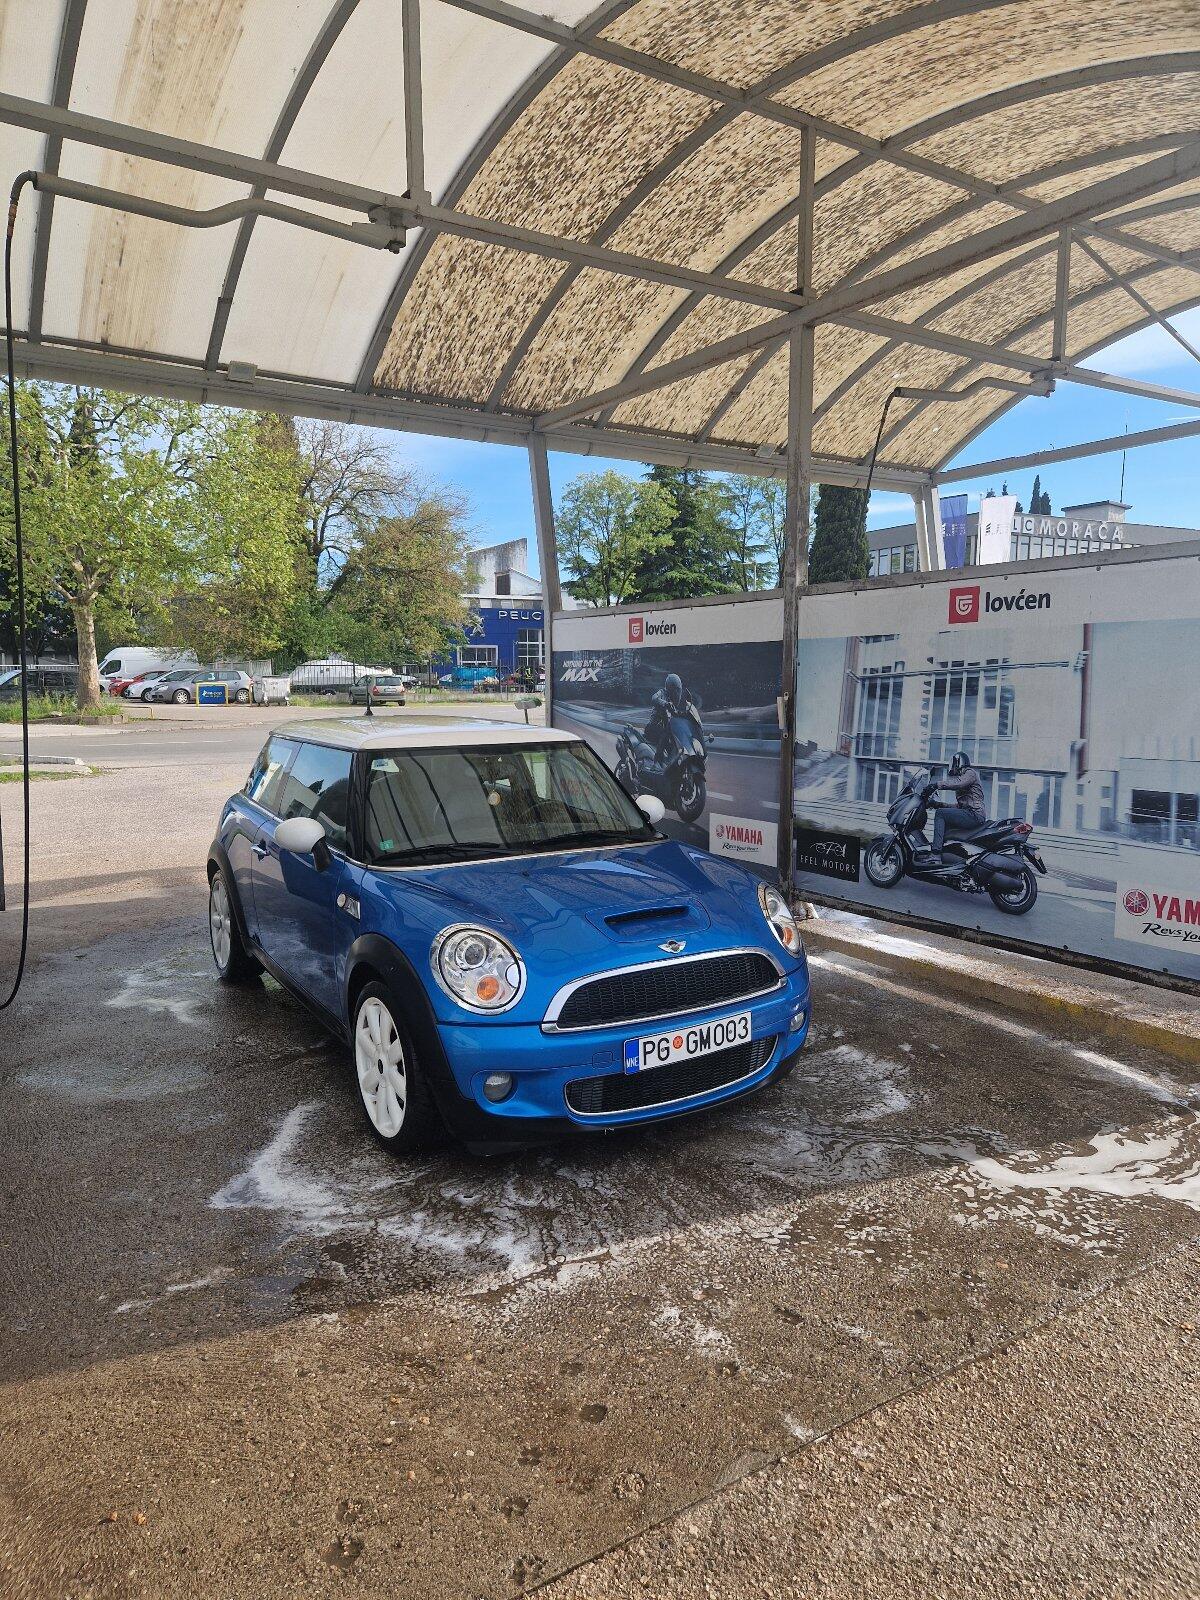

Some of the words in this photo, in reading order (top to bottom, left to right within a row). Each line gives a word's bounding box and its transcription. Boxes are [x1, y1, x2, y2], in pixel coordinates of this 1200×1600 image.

[985, 589, 1051, 612] lovćen
[645, 620, 677, 635] lovćen
[560, 668, 600, 681] MAX
[725, 825, 763, 846] YAMAHA
[822, 859, 856, 874] MOTORS
[1142, 922, 1183, 938] Revs
[626, 1056, 640, 1068] MNE
[642, 1037, 670, 1066] PG
[686, 1016, 749, 1055] GM003
